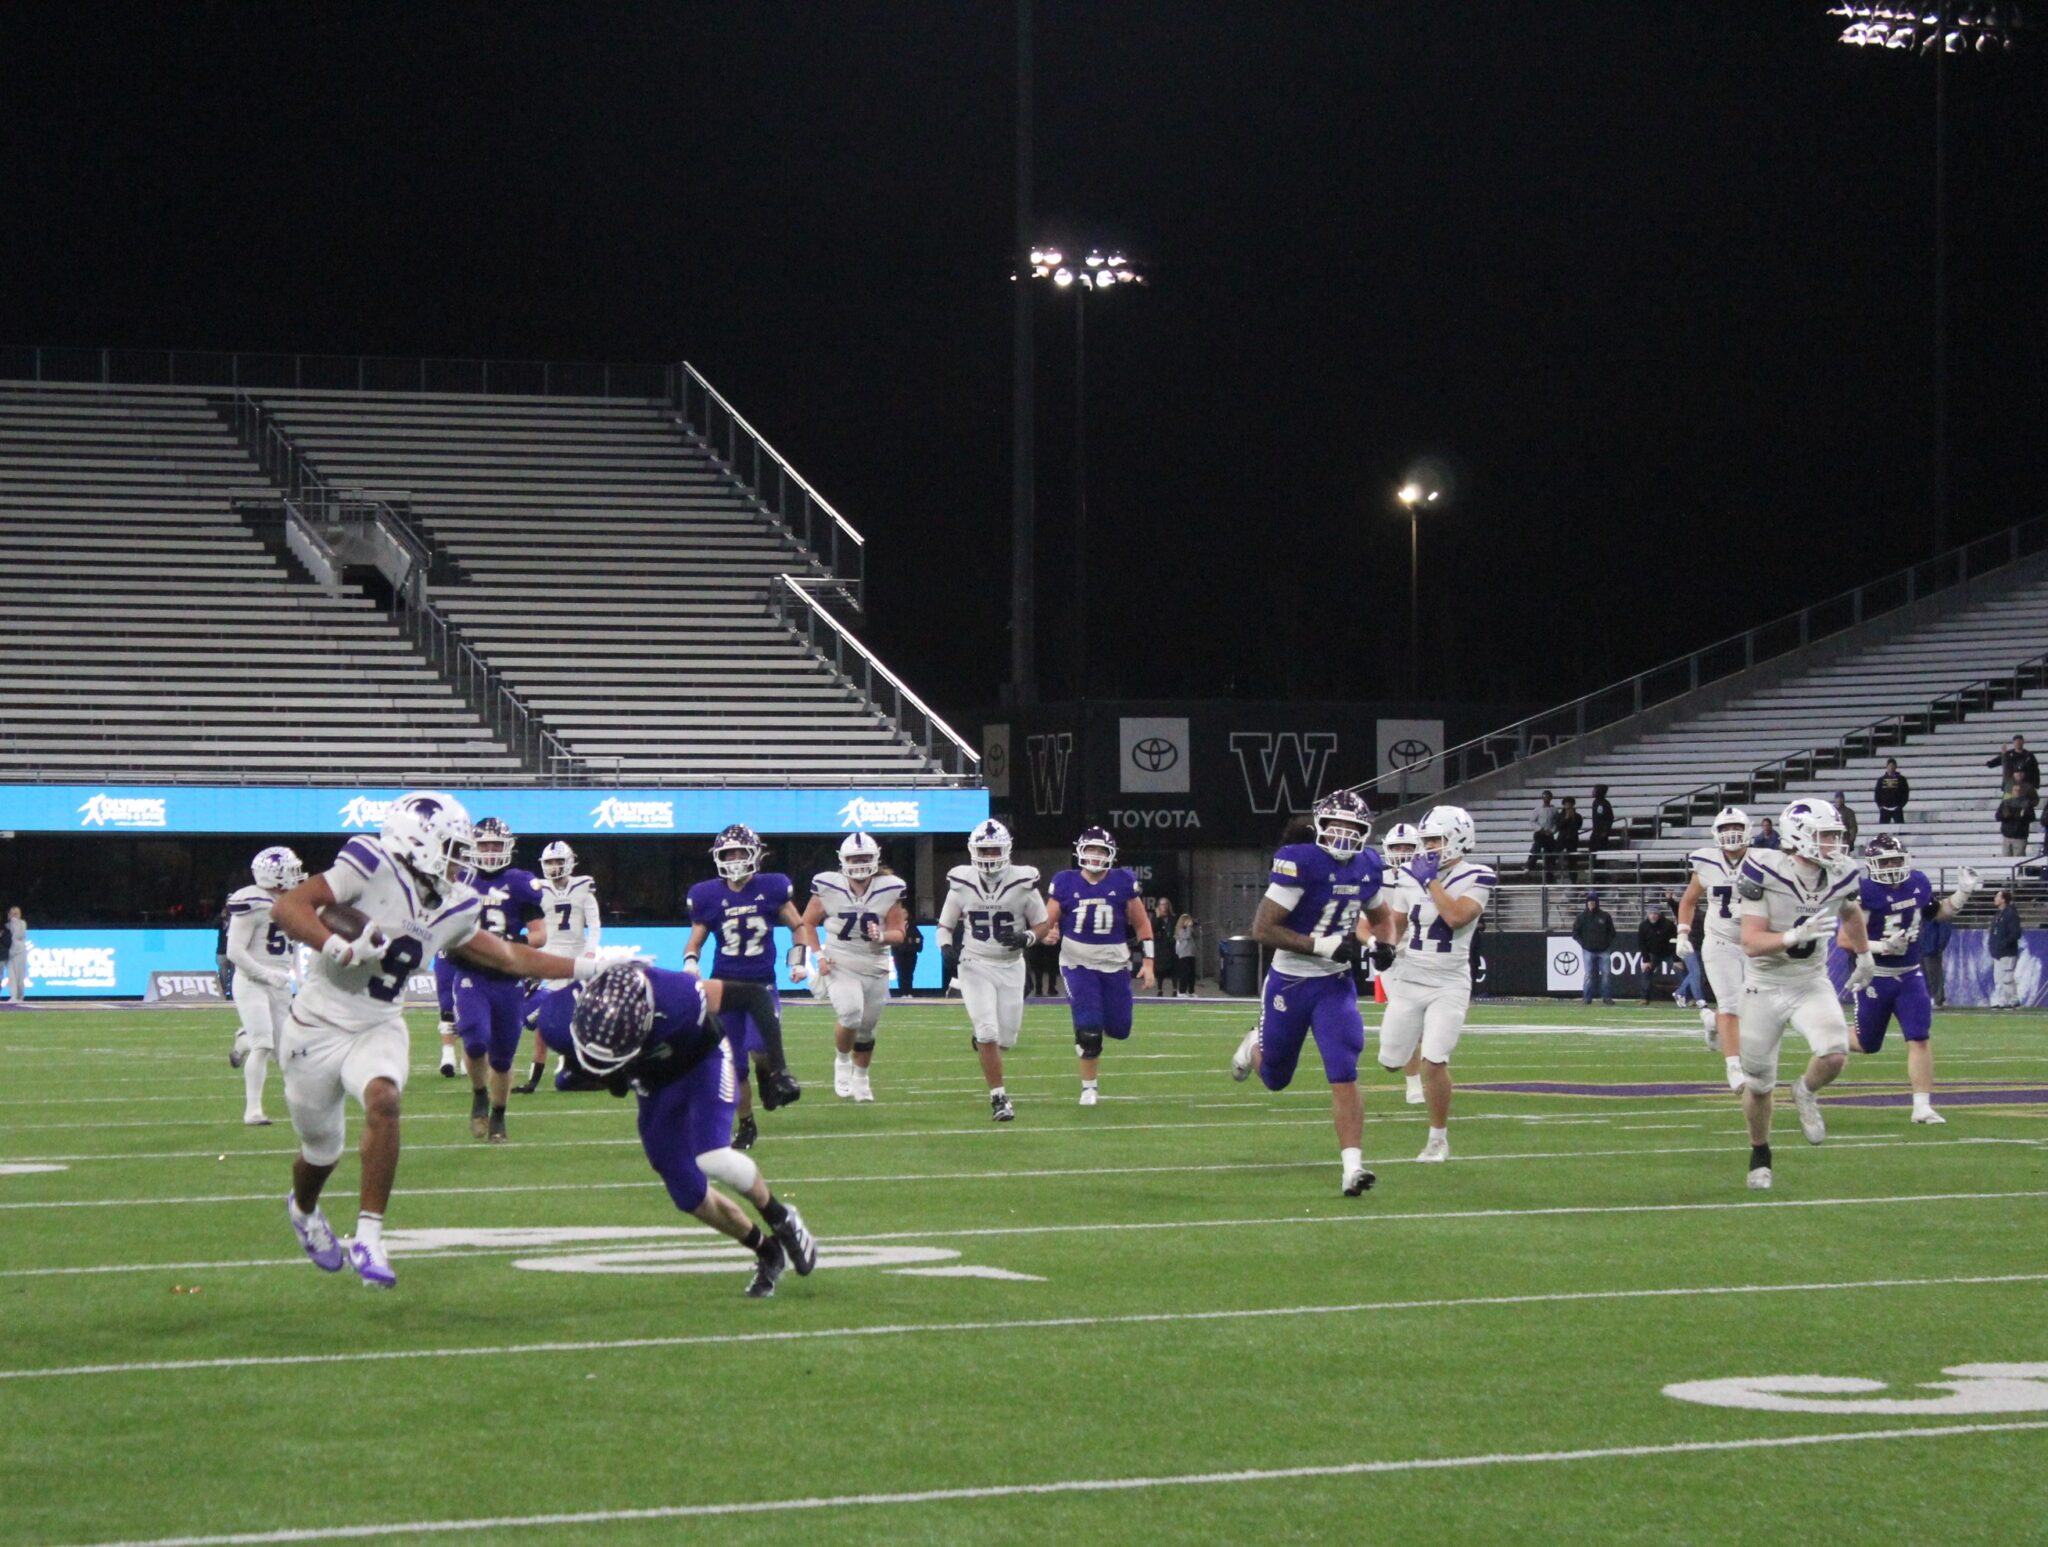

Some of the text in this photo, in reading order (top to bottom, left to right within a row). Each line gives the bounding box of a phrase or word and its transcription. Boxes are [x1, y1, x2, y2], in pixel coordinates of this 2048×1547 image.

[1108, 810, 1201, 828] TOYOTA
[400, 919, 434, 941] SUMNER
[554, 903, 572, 931] 7
[967, 910, 1015, 943] 56
[266, 922, 294, 955] 5
[721, 915, 769, 957] 52
[27, 947, 115, 967] OLYMPIC
[367, 934, 424, 1003] 9
[156, 975, 220, 997] STATE
